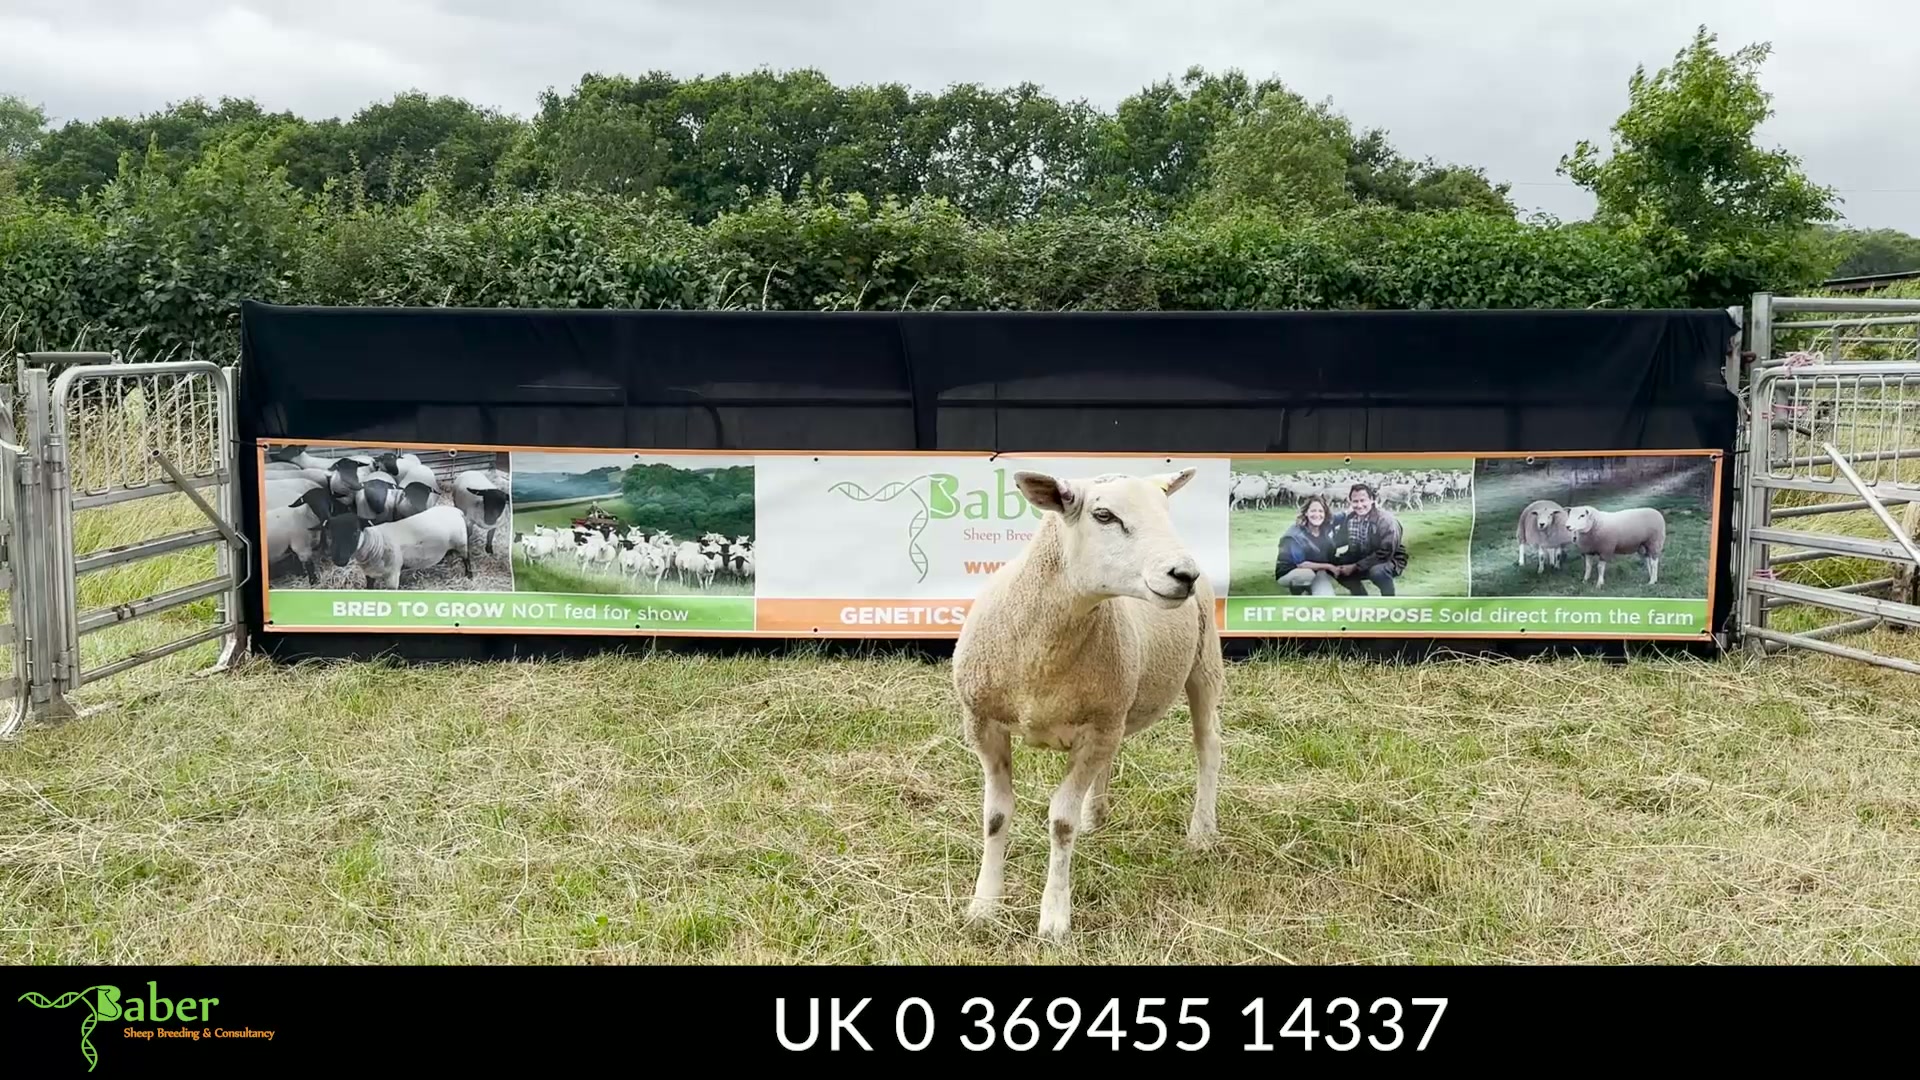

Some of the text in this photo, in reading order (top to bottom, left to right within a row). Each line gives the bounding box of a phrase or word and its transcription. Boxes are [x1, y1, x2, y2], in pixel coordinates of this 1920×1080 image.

[963, 527, 1001, 544] Sheep
[964, 561, 1006, 575] ww
[332, 601, 689, 621] BRED TO GROW NOT fed for show
[839, 606, 966, 625] GENETICS
[1243, 606, 1694, 625] FIT FOR PURPOSE Sold direct from the farm
